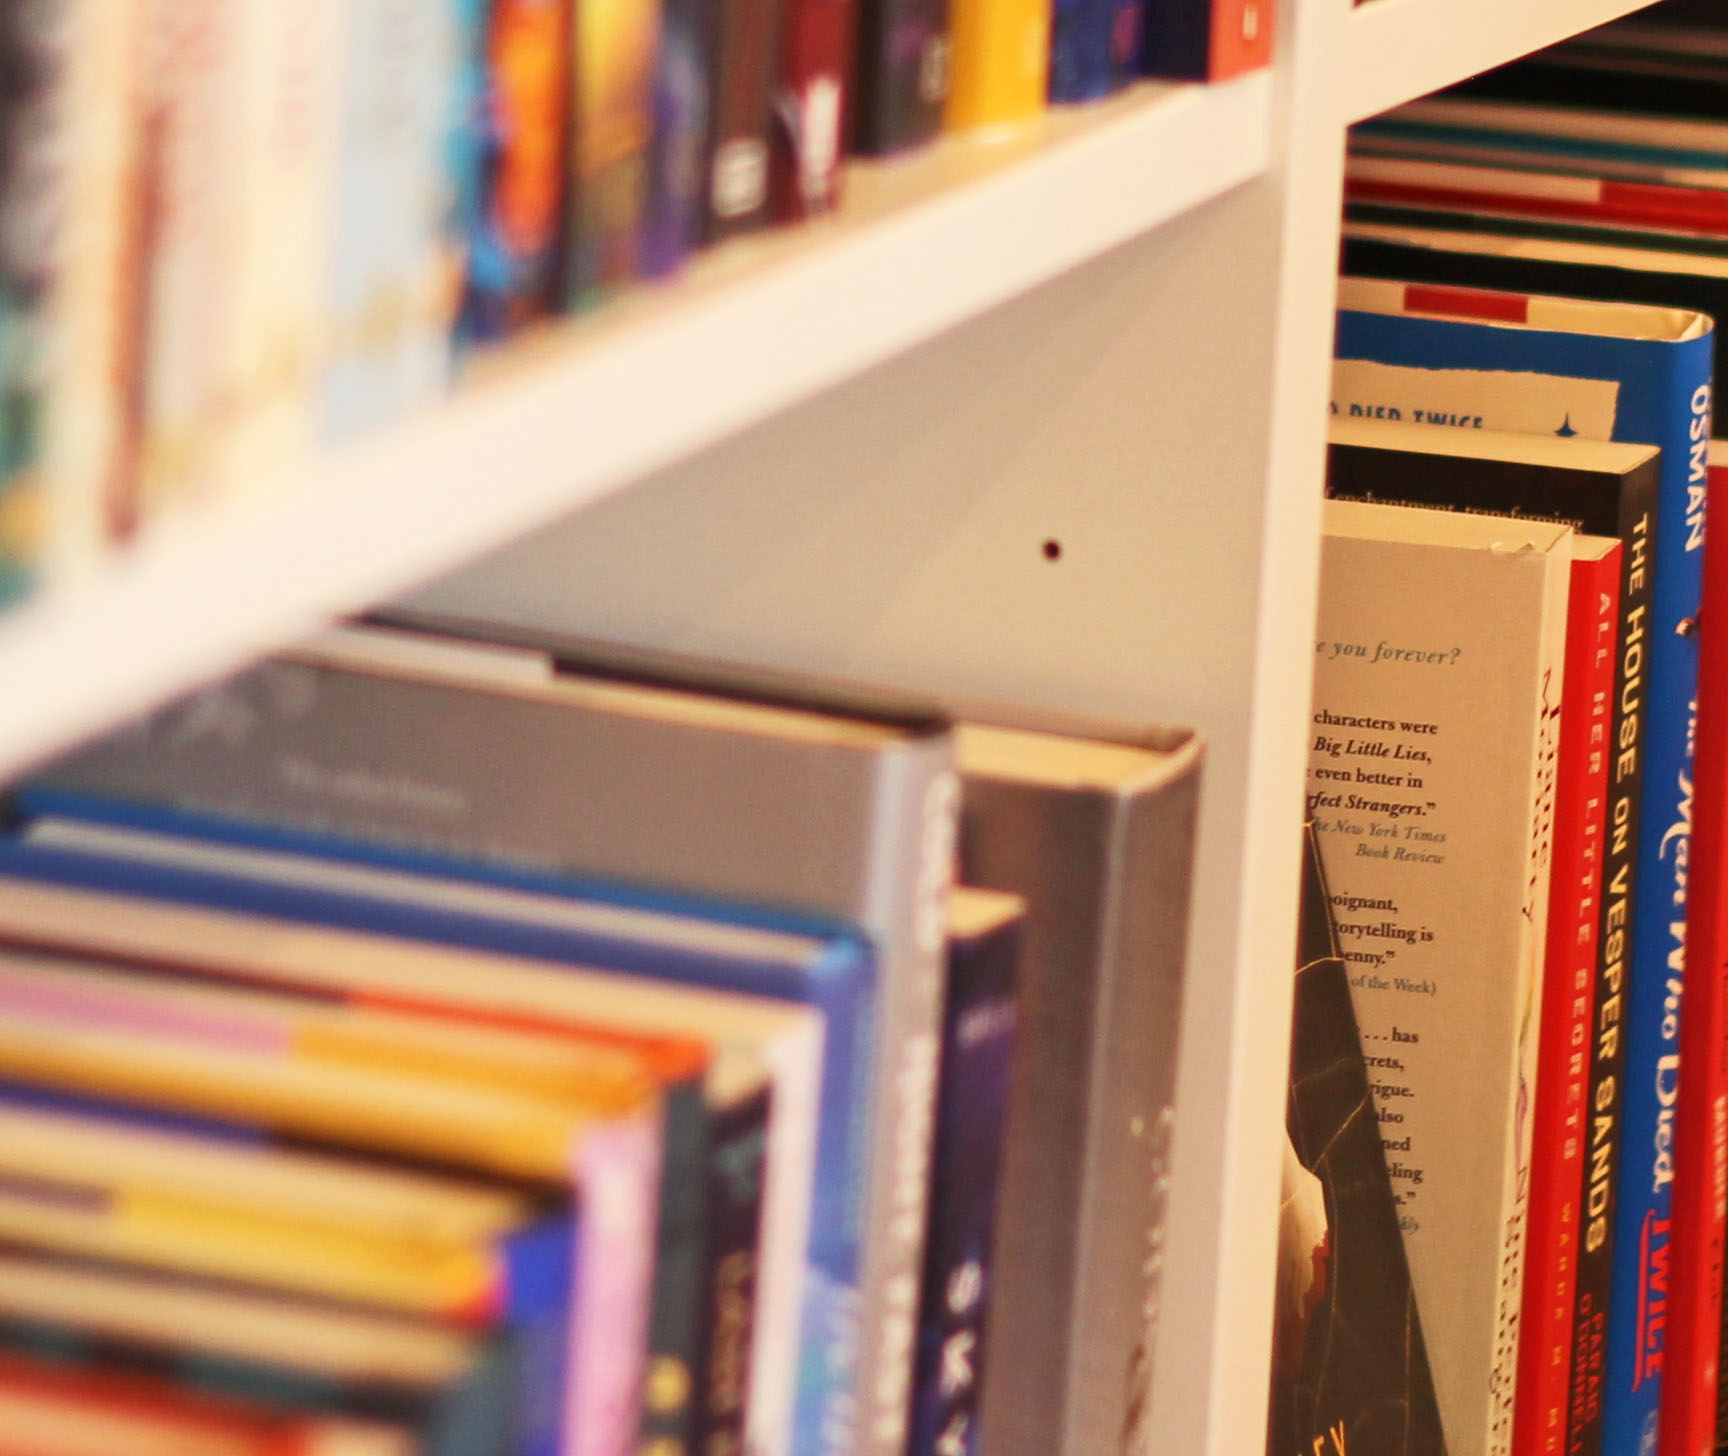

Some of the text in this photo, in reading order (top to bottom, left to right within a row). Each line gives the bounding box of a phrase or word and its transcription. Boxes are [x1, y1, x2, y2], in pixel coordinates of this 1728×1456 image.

[1683, 384, 1712, 552] OSMAN
[1328, 640, 1367, 660] you
[1371, 640, 1462, 665] forever?
[1314, 708, 1438, 736] characters were
[1313, 736, 1432, 764] Big Little Lies,
[1315, 766, 1424, 789] even better in
[1330, 819, 1365, 836] New
[1369, 822, 1400, 839] York
[1404, 825, 1447, 843] Times
[1656, 769, 1694, 908] Man
[1355, 843, 1445, 865] Book Review
[1564, 592, 1611, 1160] ALL HER LITTLE SECRETS
[1584, 512, 1648, 1253] THE HOUSE ON VESPER SANDS
[1420, 925, 1434, 943] is
[1342, 950, 1396, 968] enny.”
[1351, 976, 1437, 996] of the Week)
[1661, 921, 1687, 1040] Who
[1392, 1025, 1420, 1045] has
[1649, 1053, 1680, 1194] Died
